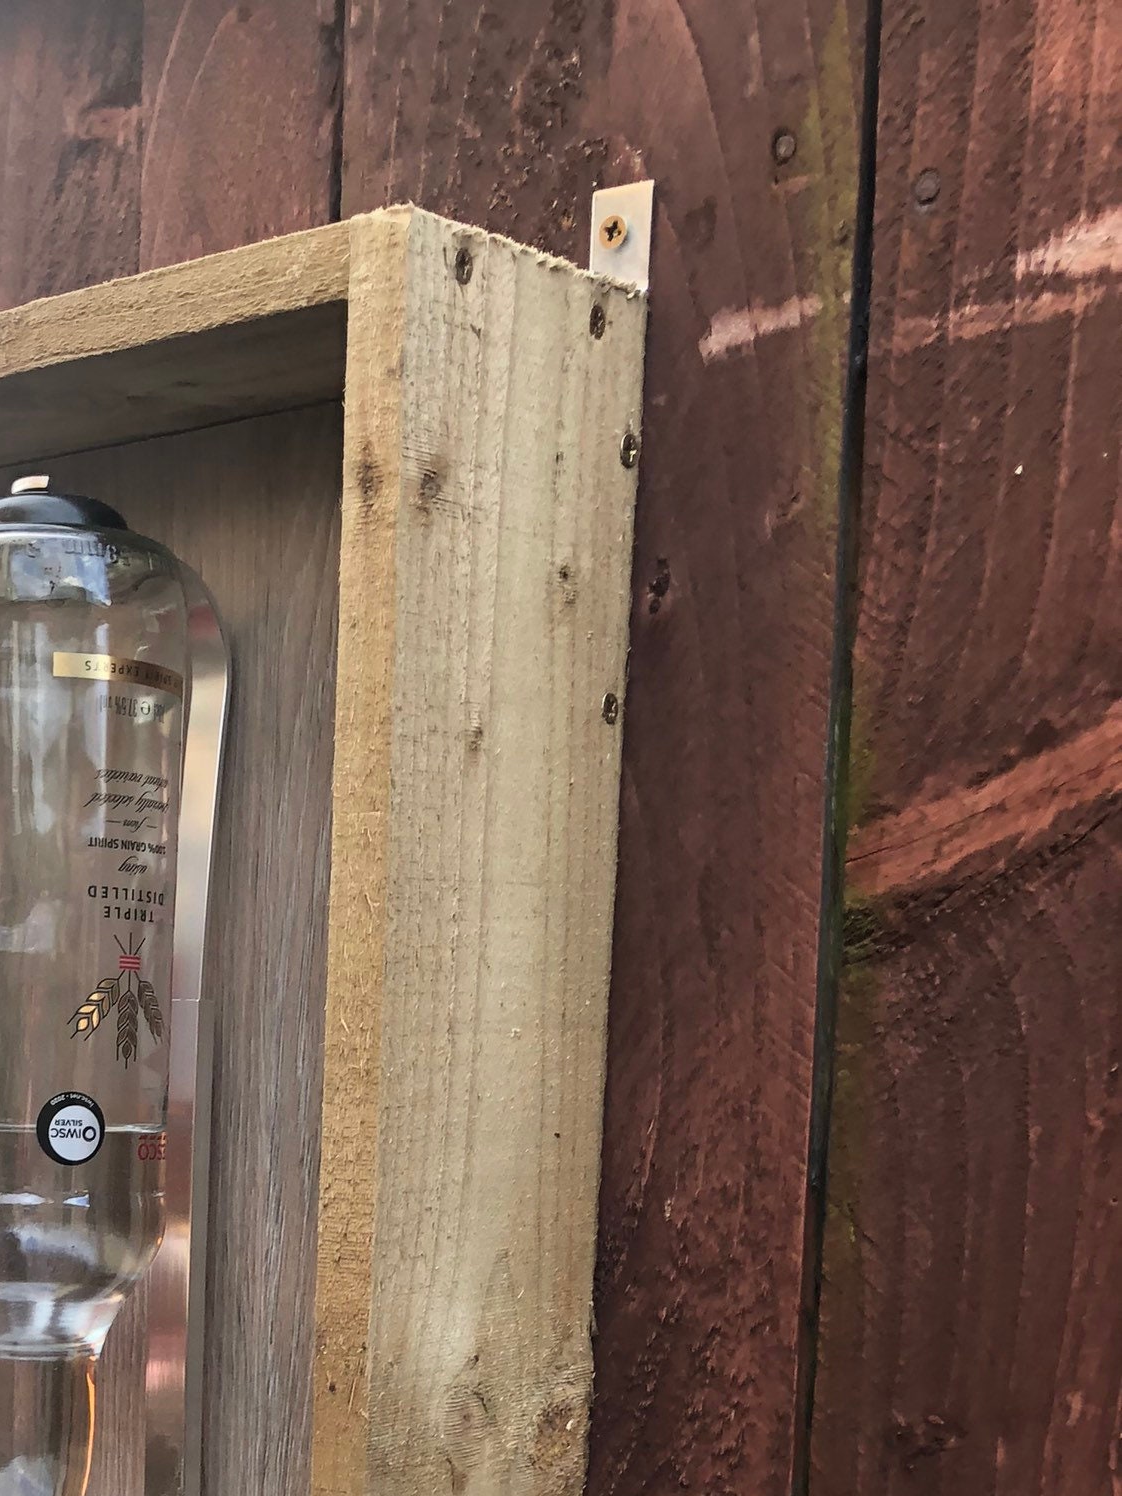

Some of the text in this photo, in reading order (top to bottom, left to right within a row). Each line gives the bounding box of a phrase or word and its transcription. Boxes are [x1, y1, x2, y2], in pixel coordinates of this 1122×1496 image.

[85, 660, 138, 674] EXPERTS
[83, 793, 134, 809] selected
[88, 837, 118, 849] SPIRIT
[121, 840, 146, 852] GRAIN
[118, 856, 147, 875] using
[88, 886, 164, 905] DISTILLED
[104, 906, 154, 922] TRIPLE
